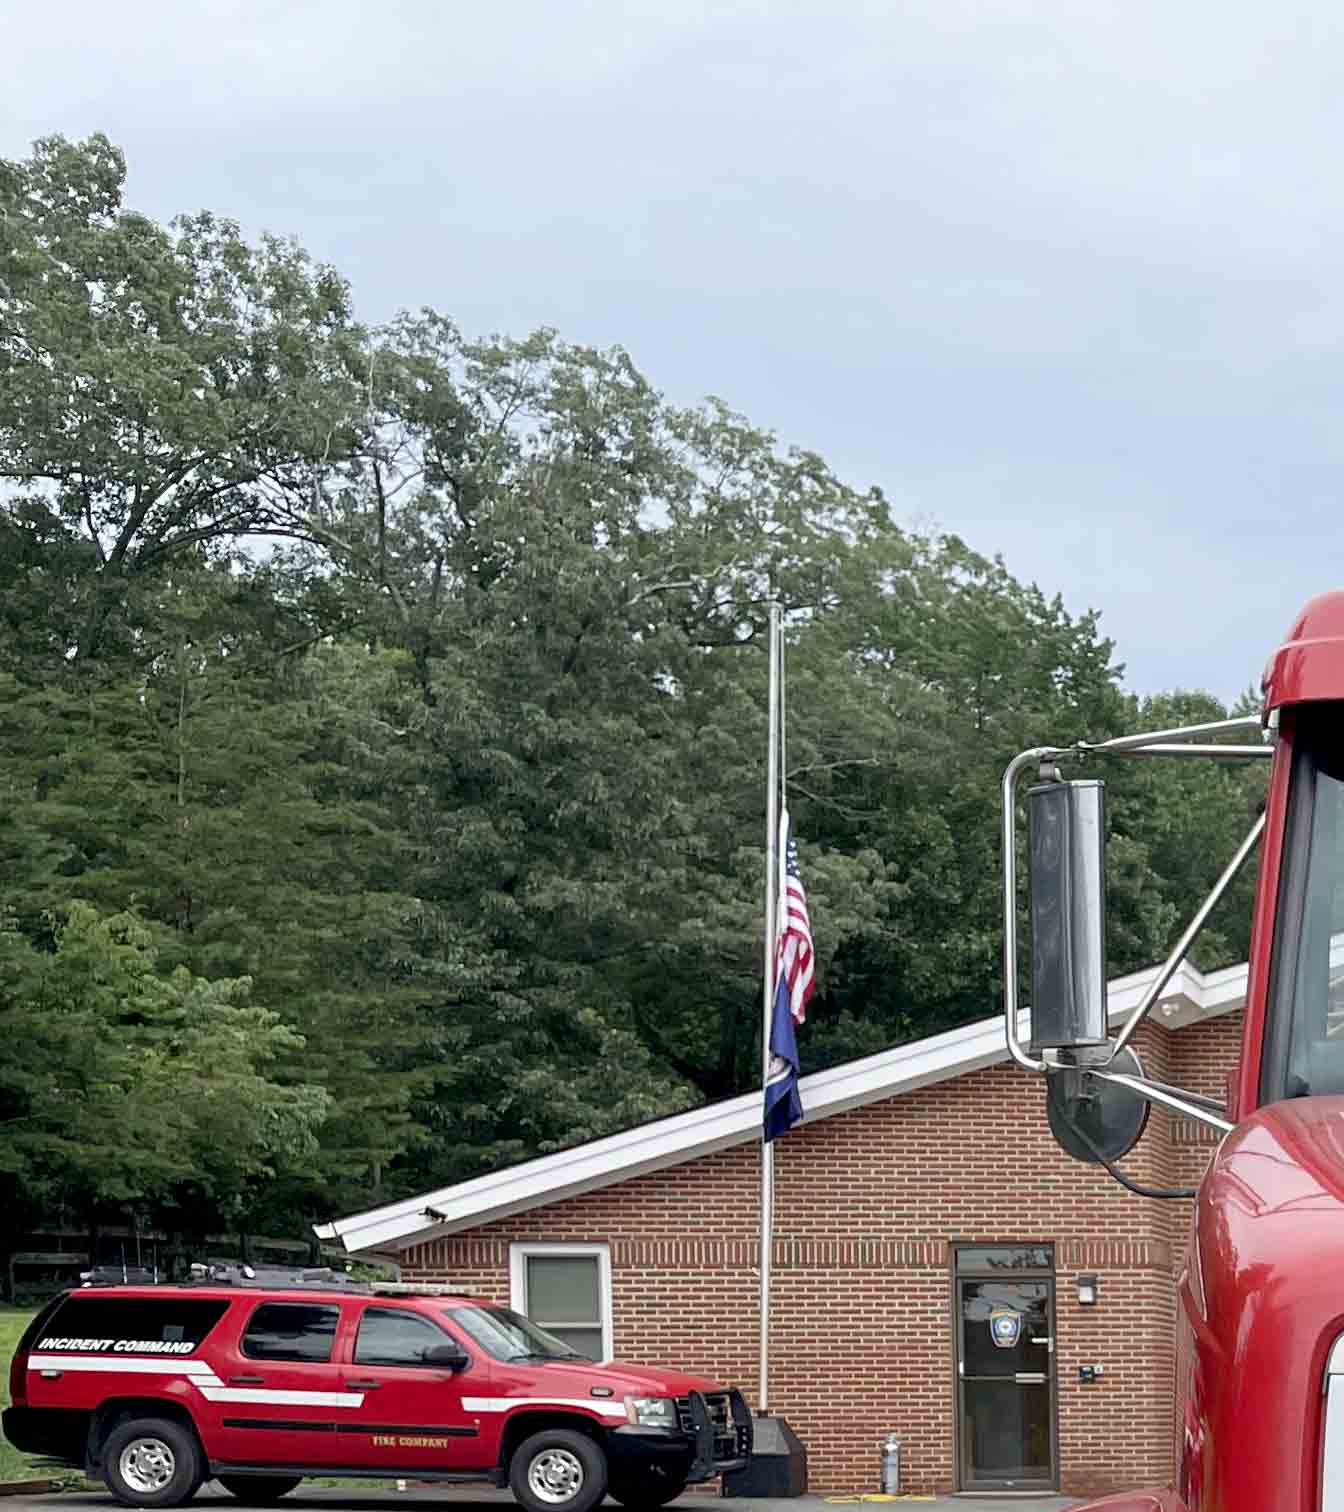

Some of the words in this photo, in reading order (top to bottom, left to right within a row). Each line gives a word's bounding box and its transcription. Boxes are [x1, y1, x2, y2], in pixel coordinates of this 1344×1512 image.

[38, 1338, 114, 1351] INCIDENT
[113, 1340, 195, 1354] COMMAND
[399, 1437, 449, 1449] COMPANY
